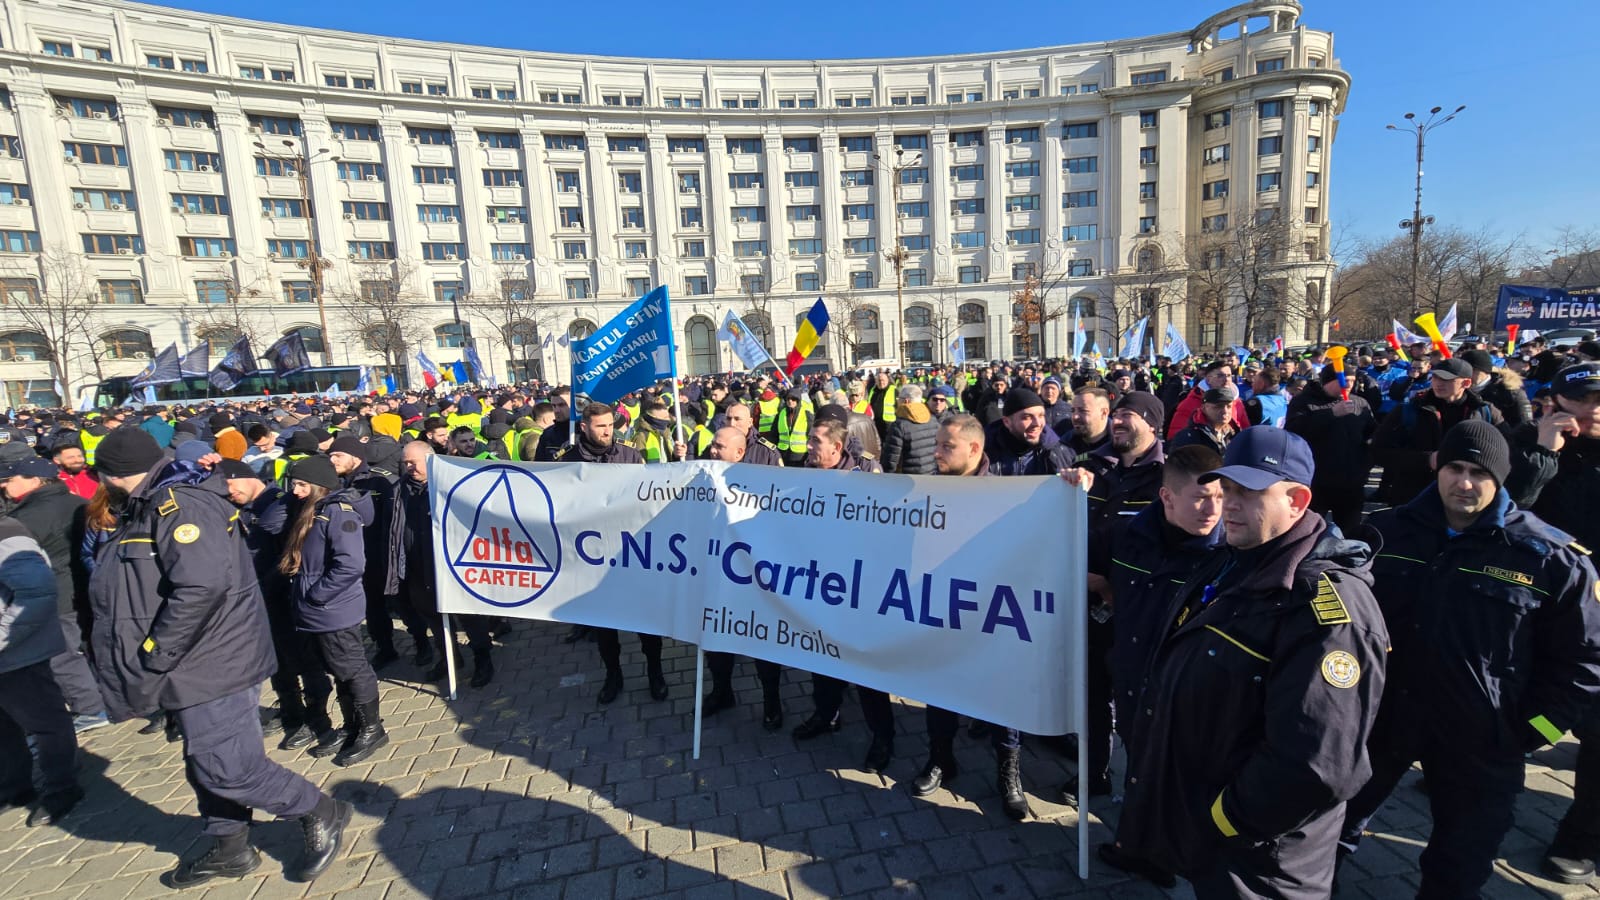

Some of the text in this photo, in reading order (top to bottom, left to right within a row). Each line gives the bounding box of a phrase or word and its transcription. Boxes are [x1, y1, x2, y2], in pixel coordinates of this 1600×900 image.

[637, 480, 947, 530] Uniunea Sindicală Teritorială
[472, 526, 534, 564] alfa
[464, 567, 542, 590] CARTEL
[575, 530, 1055, 643] C.N.S. "Cartel ALFA"
[701, 606, 841, 659] Filiala Brăila
